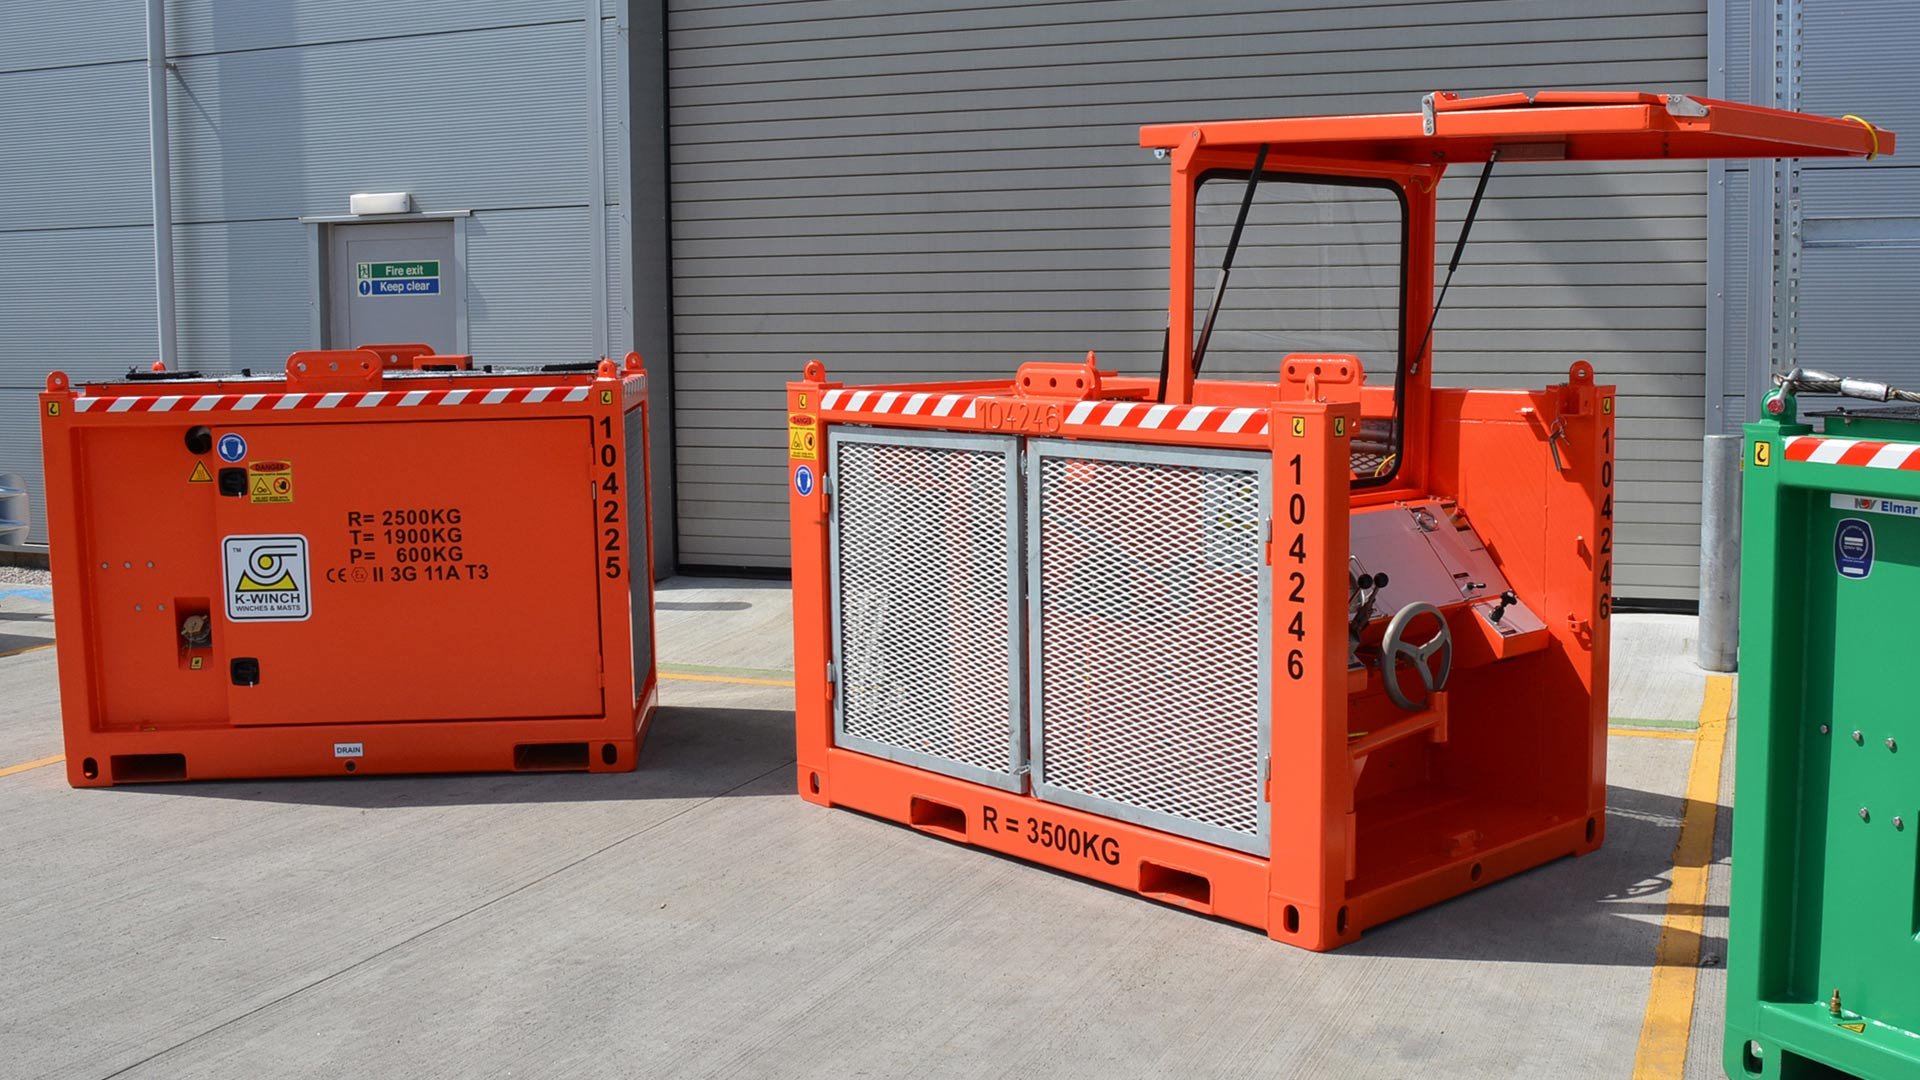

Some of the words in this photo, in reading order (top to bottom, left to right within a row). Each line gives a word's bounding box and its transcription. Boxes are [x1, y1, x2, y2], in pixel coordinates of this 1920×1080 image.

[385, 265, 404, 276] Fire
[406, 265, 424, 275] exit
[380, 281, 404, 293] Keep
[406, 281, 430, 291] clear
[980, 401, 1060, 433] 104246
[600, 416, 621, 579] 104225
[1881, 500, 1918, 515] Elmar
[382, 508, 461, 526] 2500KG
[1600, 427, 1612, 620] 104246
[384, 527, 462, 544] 1900KG
[396, 546, 463, 563] 600KG
[390, 565, 417, 582] 3G
[465, 564, 489, 580] T3
[1287, 454, 1306, 680] 104246
[235, 593, 301, 604] K-WINCH
[336, 746, 361, 754] DRAIN
[1027, 817, 1121, 866] 3500KG
